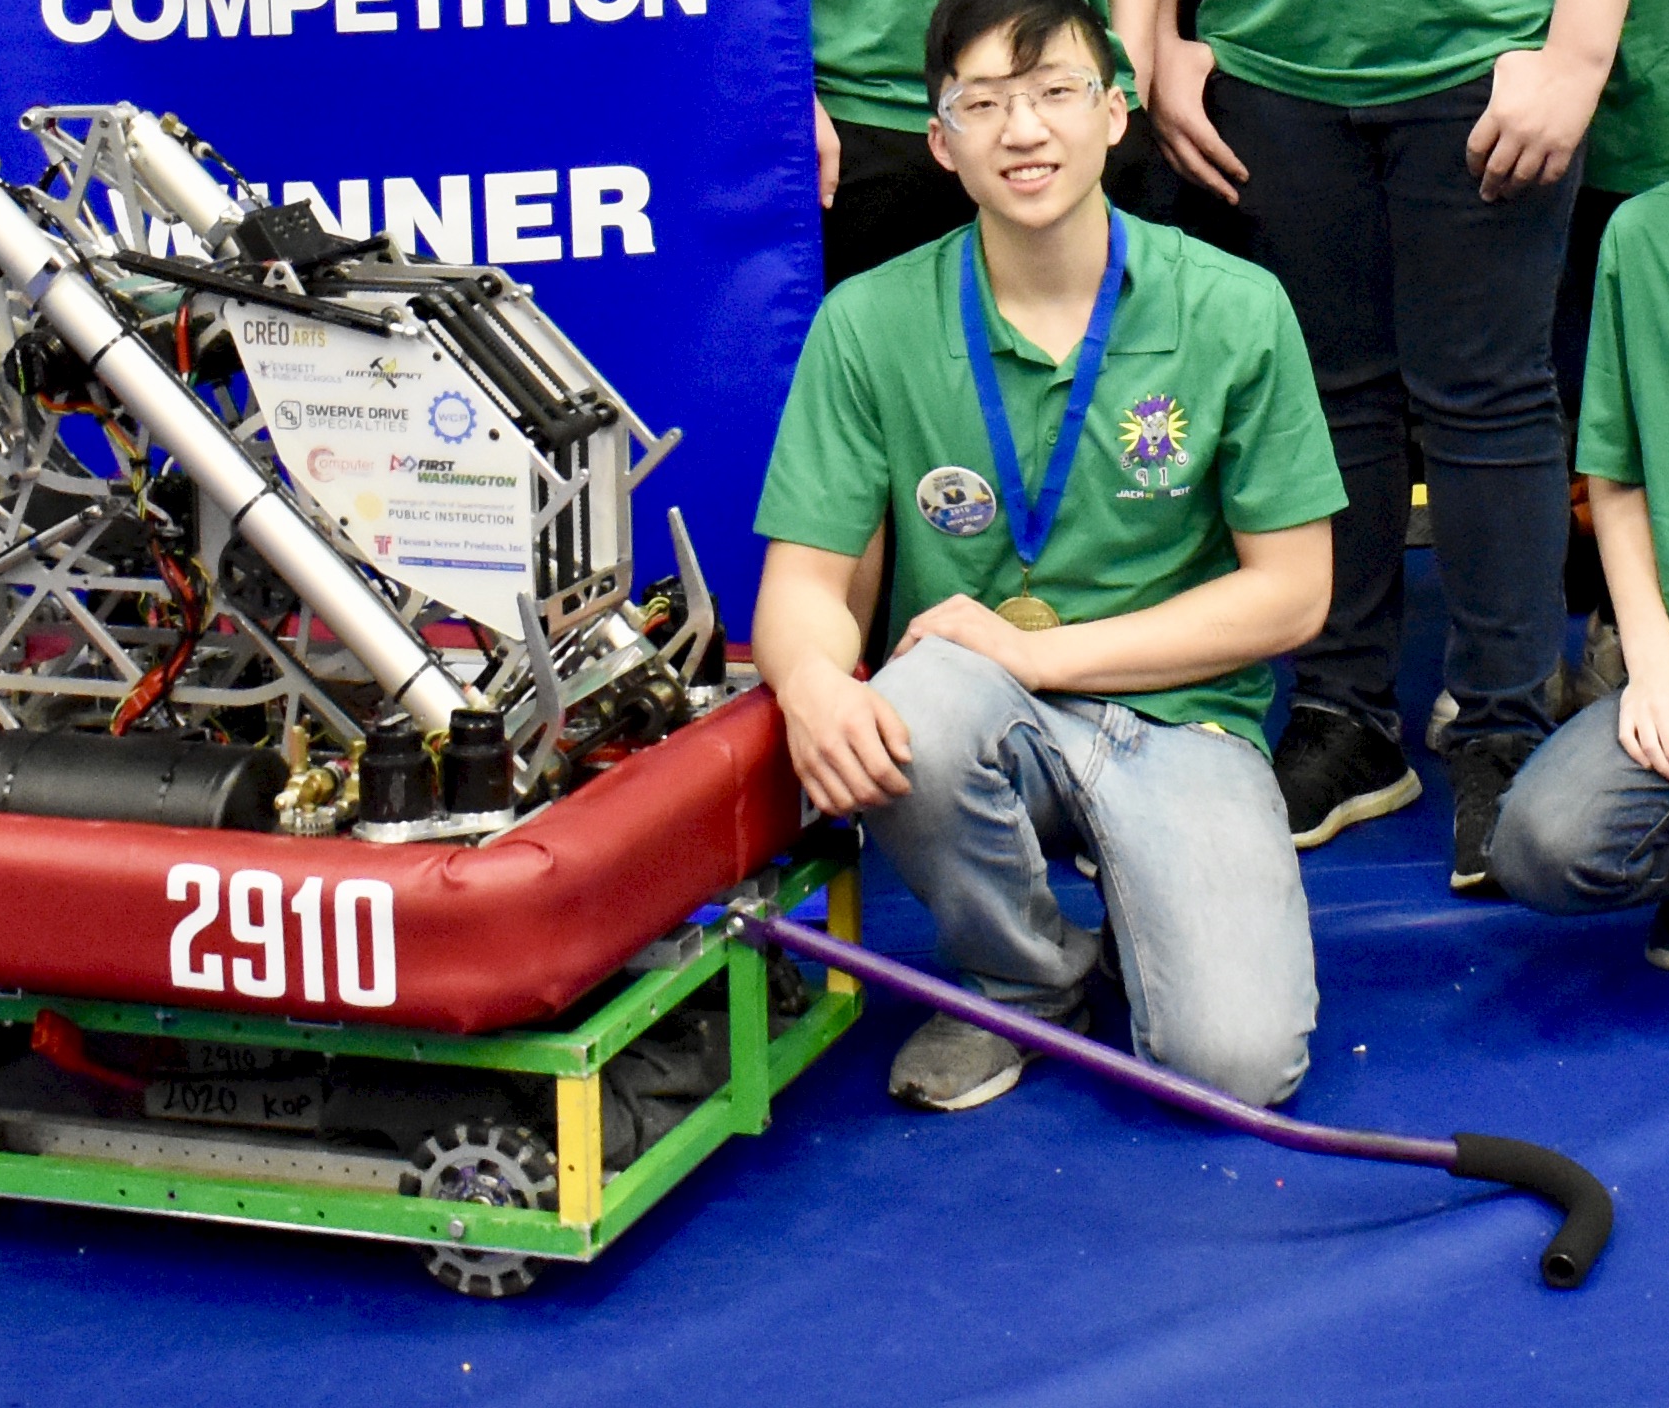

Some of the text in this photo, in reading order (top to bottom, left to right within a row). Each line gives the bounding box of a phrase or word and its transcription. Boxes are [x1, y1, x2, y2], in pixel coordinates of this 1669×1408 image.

[107, 165, 656, 267] NNER
[292, 330, 327, 348] ARTS
[306, 404, 410, 421] SWERVE DRIVE
[309, 417, 408, 433] SPECIALTIES
[417, 459, 456, 472] FIRST
[417, 472, 518, 488] WASHINGTON
[388, 509, 515, 526] PUBLIC INSTRUCTION
[165, 862, 397, 1008] 2910
[200, 1045, 257, 1072] 2910
